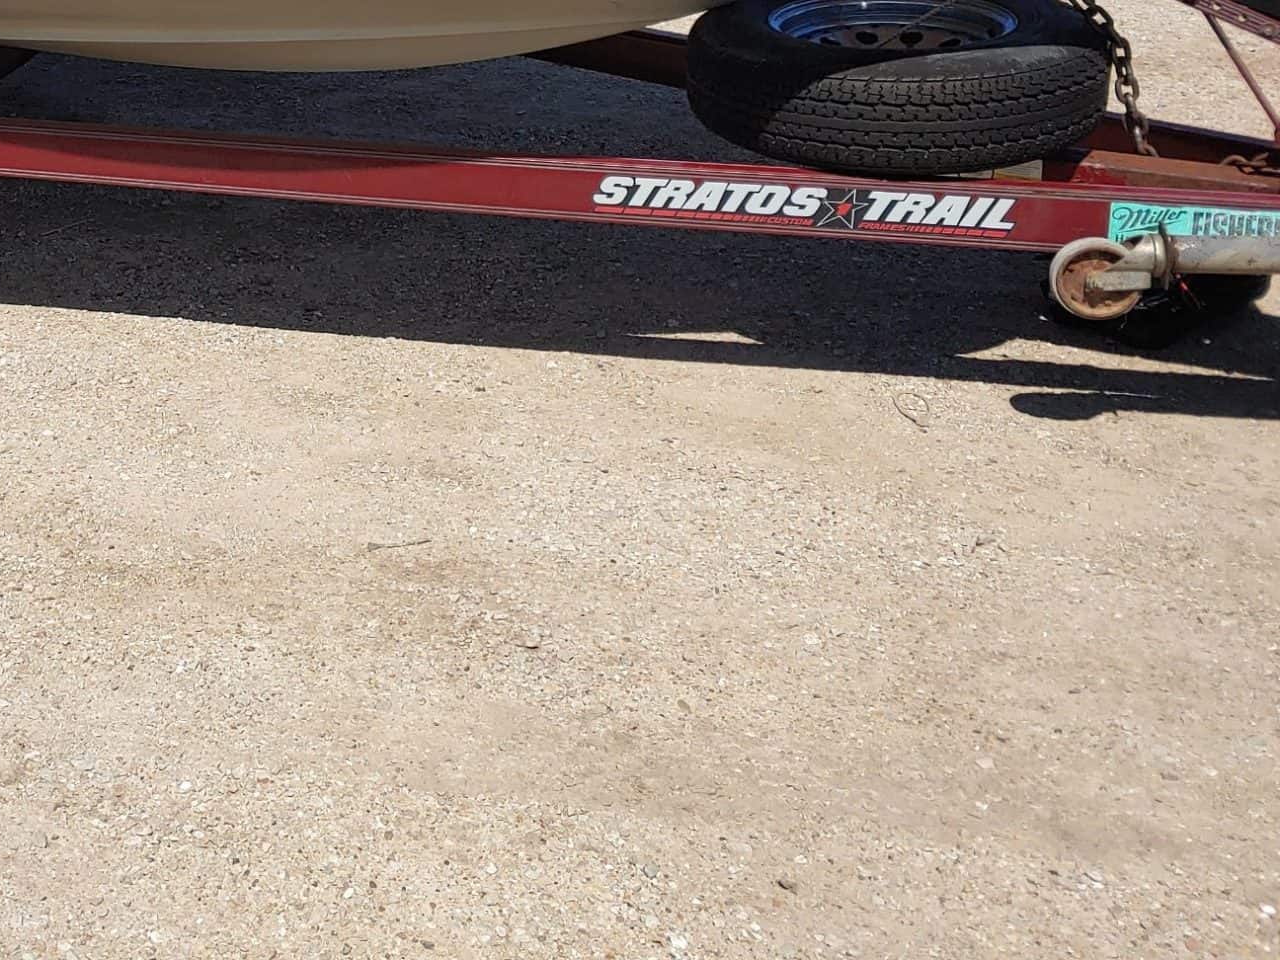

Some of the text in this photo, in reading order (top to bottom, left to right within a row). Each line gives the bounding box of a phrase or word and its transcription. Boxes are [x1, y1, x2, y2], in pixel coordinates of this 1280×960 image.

[592, 176, 1017, 230] STRATOS TRAIL
[767, 216, 907, 233] CUSTOM FRAMES
[1111, 207, 1188, 232] Miller
